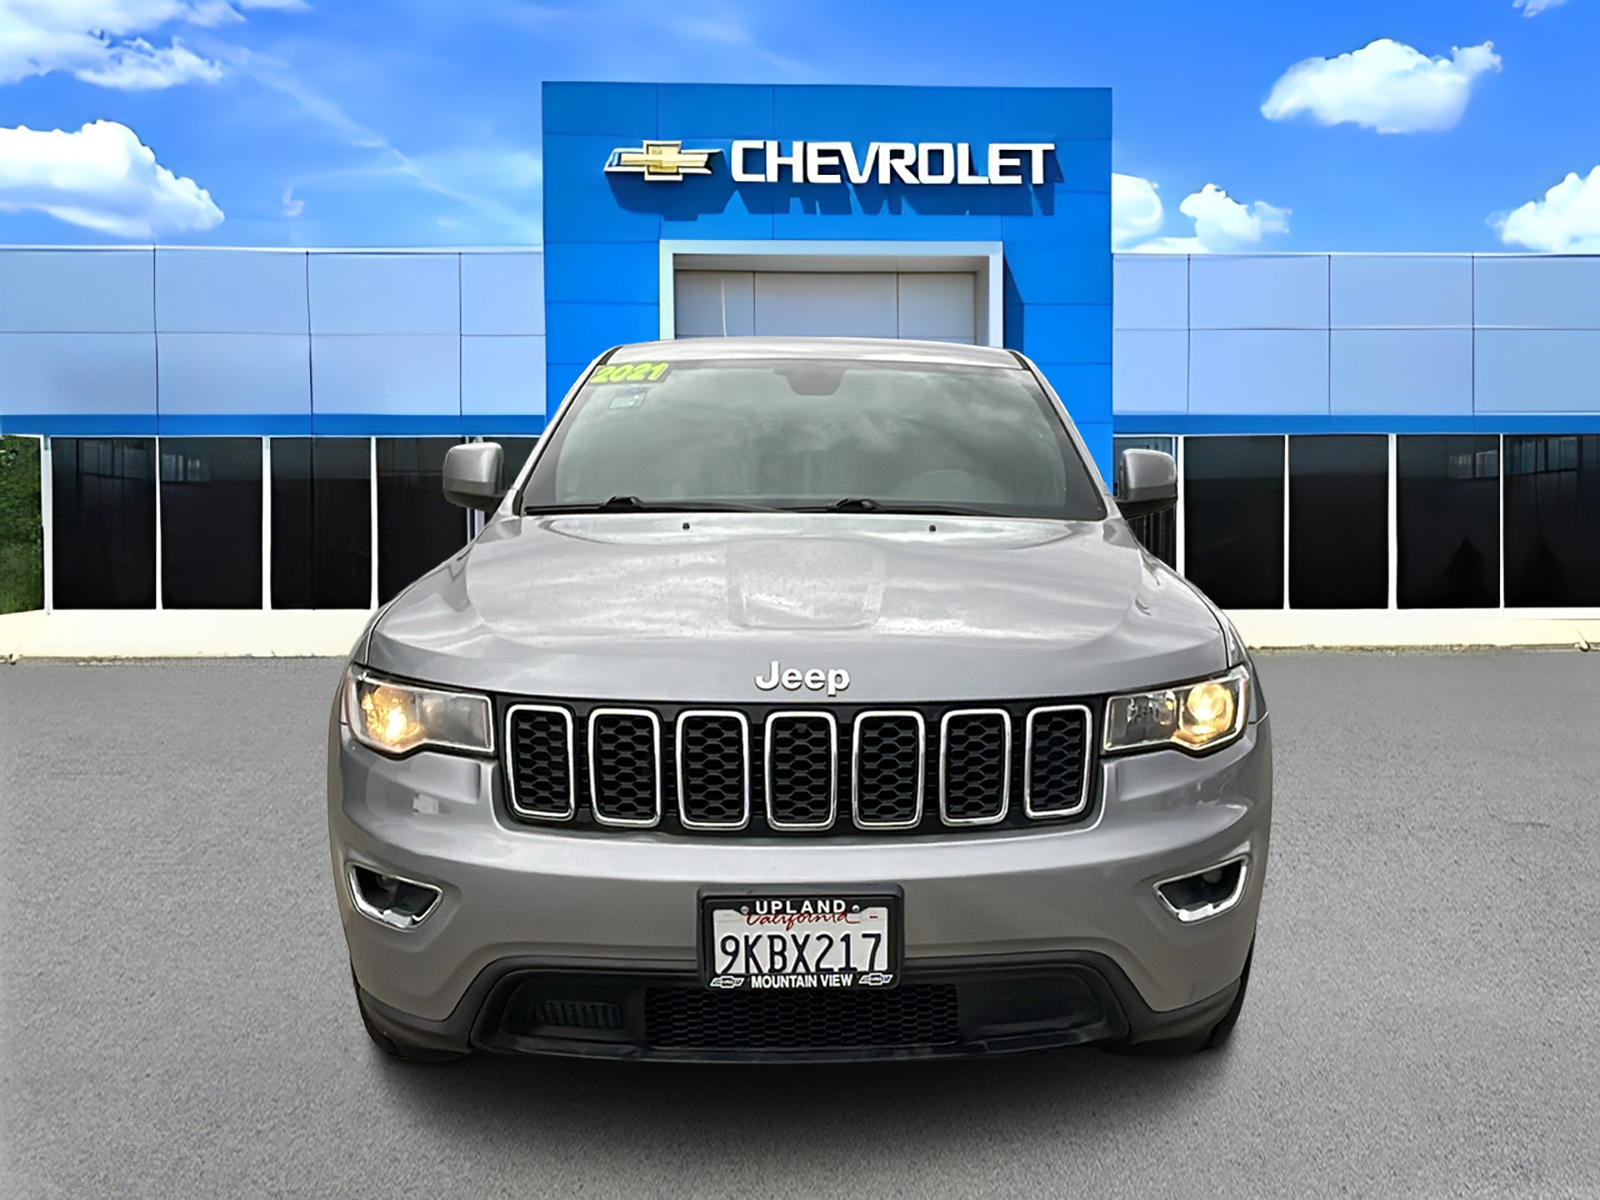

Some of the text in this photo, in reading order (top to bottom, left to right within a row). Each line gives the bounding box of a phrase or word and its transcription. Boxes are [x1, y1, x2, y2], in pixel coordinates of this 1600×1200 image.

[731, 140, 1055, 184] CHEVROLET
[590, 362, 668, 383] 2021
[754, 660, 850, 697] Jeep
[755, 900, 846, 914] UPLAND
[720, 933, 882, 974] 9KBX217
[751, 975, 819, 989] MOUNTAIN
[820, 974, 853, 987] VIEW
